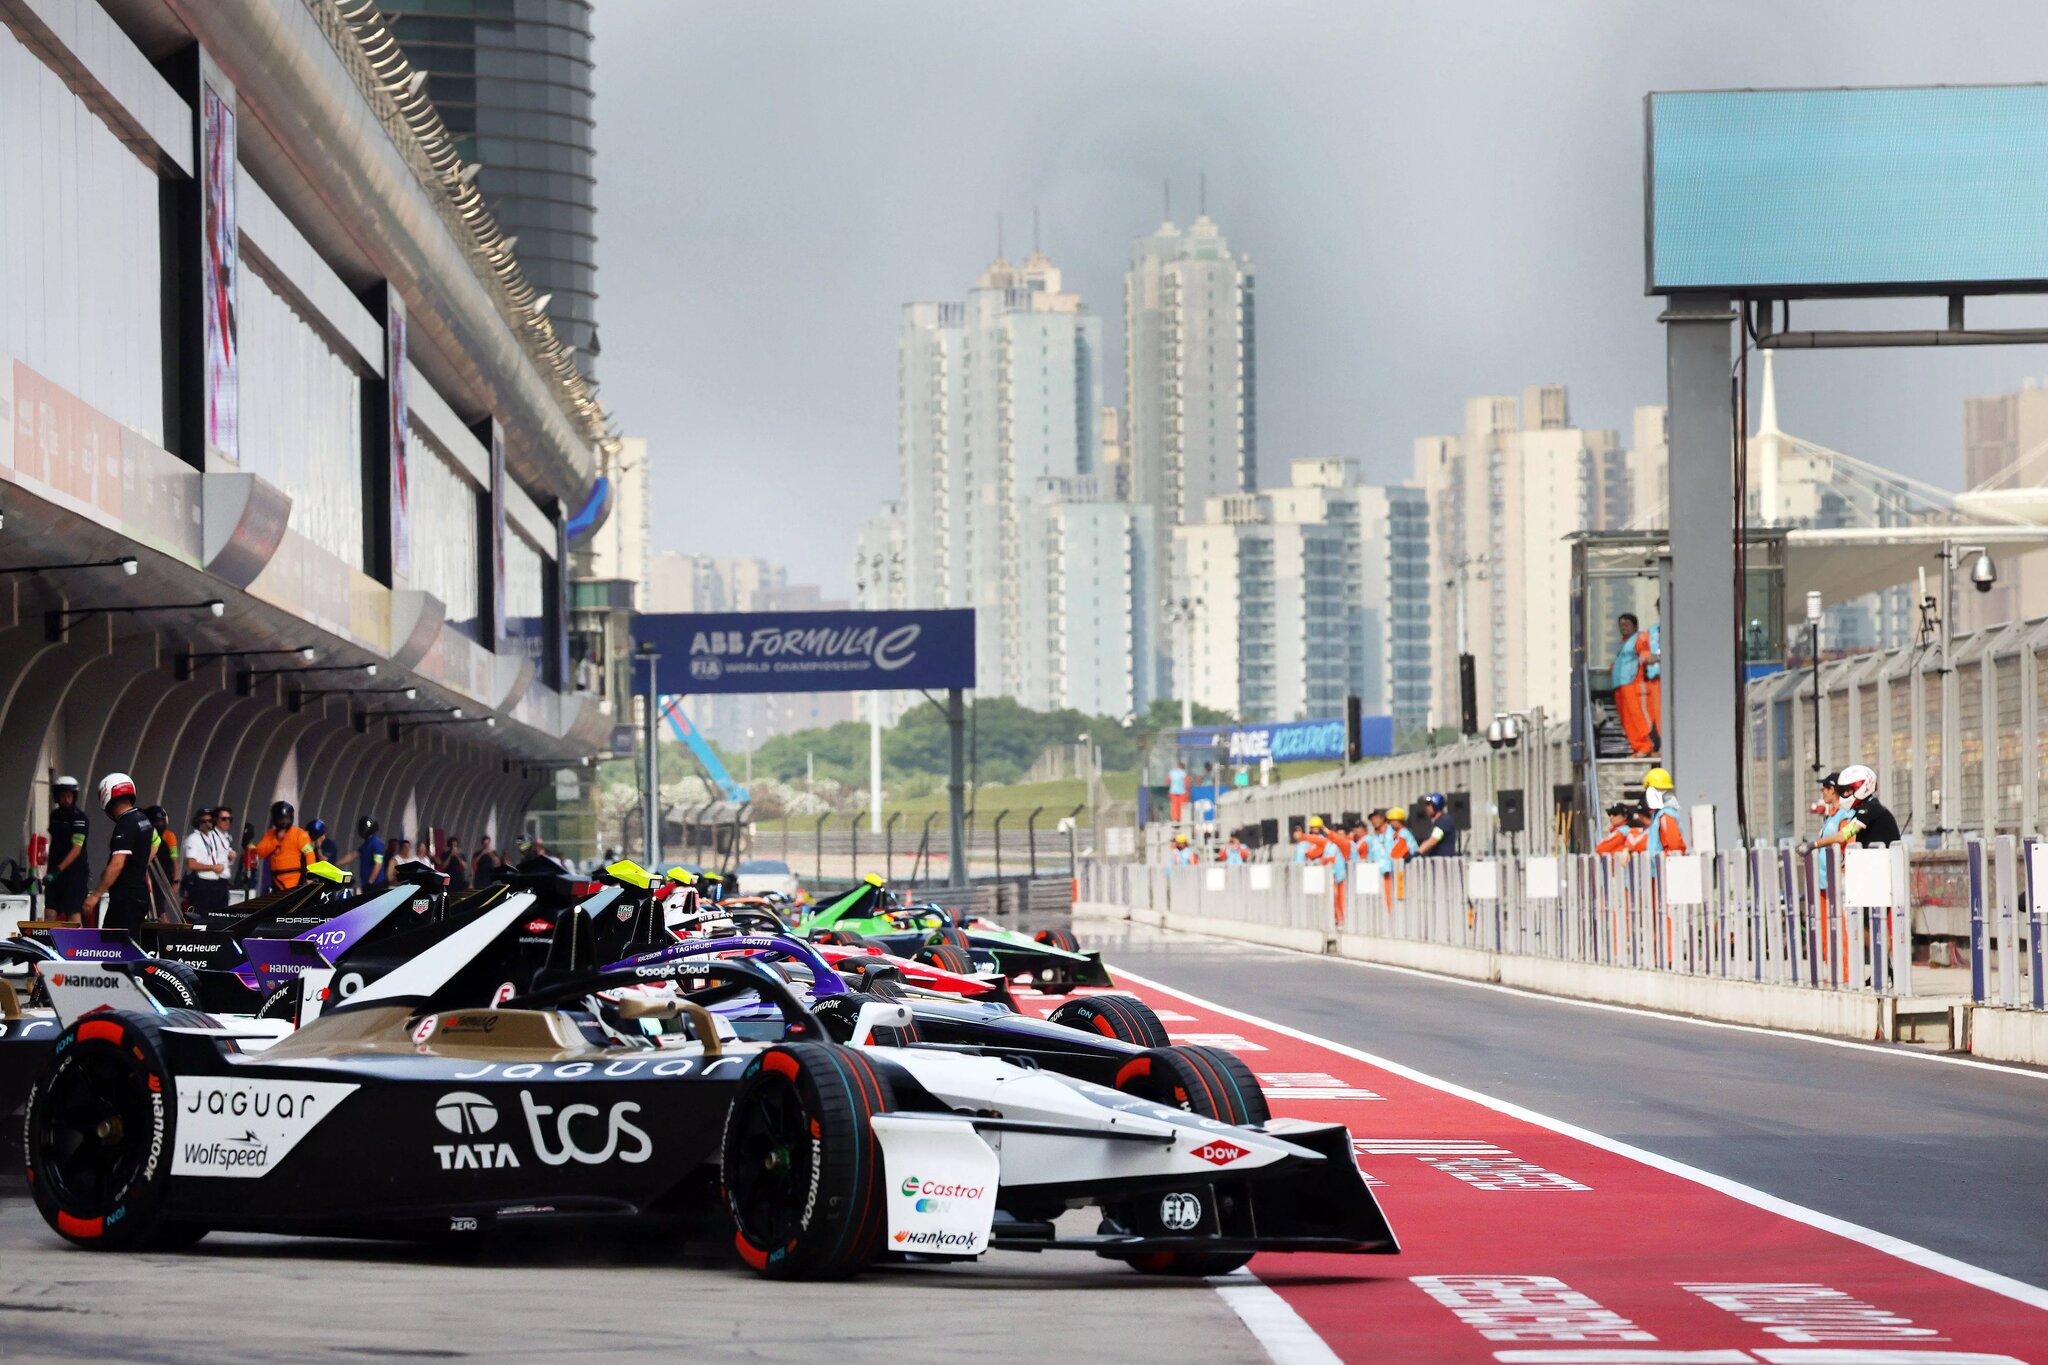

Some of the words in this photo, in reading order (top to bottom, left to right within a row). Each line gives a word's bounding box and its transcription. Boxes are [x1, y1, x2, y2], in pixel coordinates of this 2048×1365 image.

[689, 631, 744, 655] ABB
[746, 625, 878, 656] FORMULA
[724, 661, 770, 673] WORLD
[773, 660, 871, 672] CHAMPIONSHIP
[698, 911, 734, 922] NISSAN
[741, 938, 773, 946] LOCTITE
[635, 964, 676, 979] Google
[677, 963, 710, 975] Cloud
[185, 1142, 268, 1171] Wolfspeed
[433, 1143, 521, 1171] TATA
[922, 1181, 984, 1200] Castrol
[450, 1220, 478, 1231] AERO
